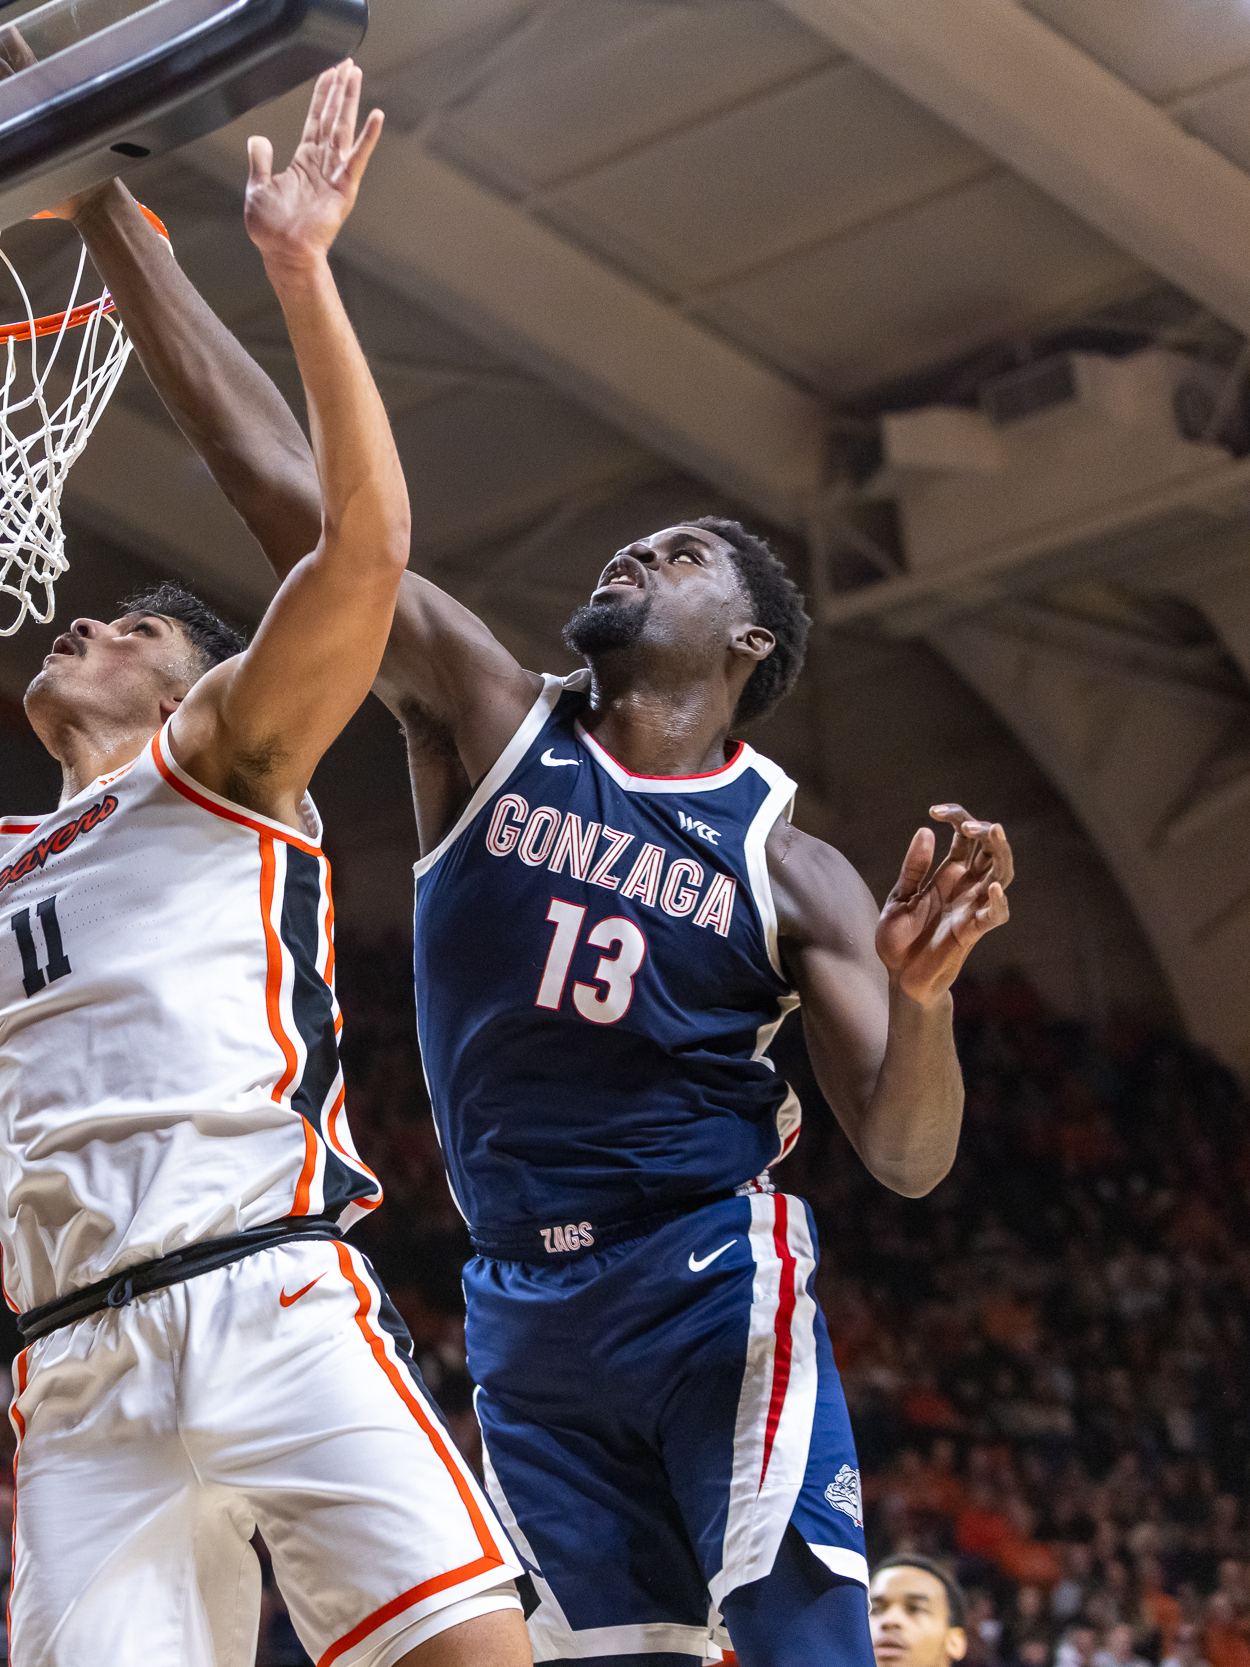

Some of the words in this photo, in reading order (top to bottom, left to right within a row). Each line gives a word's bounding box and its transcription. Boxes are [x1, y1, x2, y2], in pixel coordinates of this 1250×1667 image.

[486, 793, 737, 938] GONZAGA
[677, 810, 722, 845] WCC
[11, 895, 72, 998] 11
[534, 896, 647, 1025] 13
[540, 1221, 594, 1253] ZAGS
